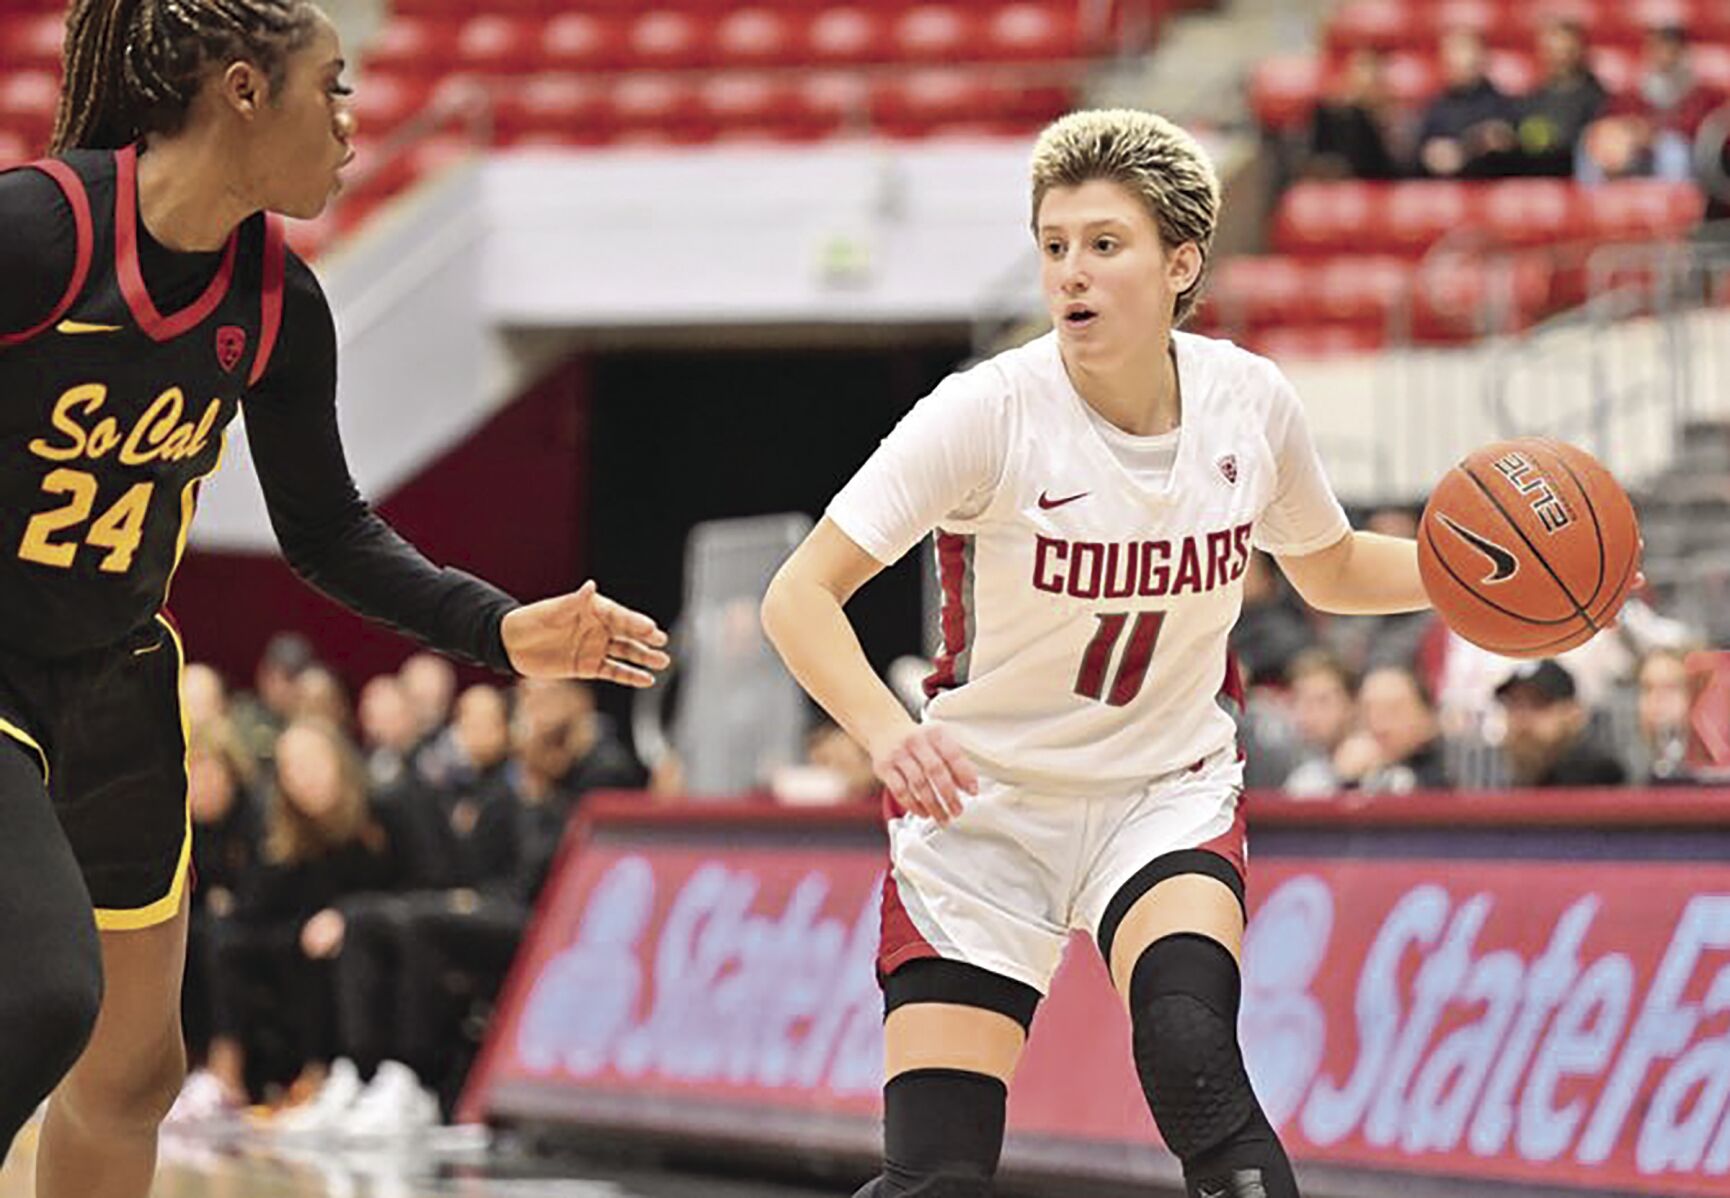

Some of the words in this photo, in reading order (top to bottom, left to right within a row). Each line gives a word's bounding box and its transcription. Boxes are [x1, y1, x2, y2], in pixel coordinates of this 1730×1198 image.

[17, 467, 154, 572] 24
[1492, 451, 1571, 534] ELITE
[1032, 521, 1253, 600] COUGARS
[1073, 610, 1167, 707] 11
